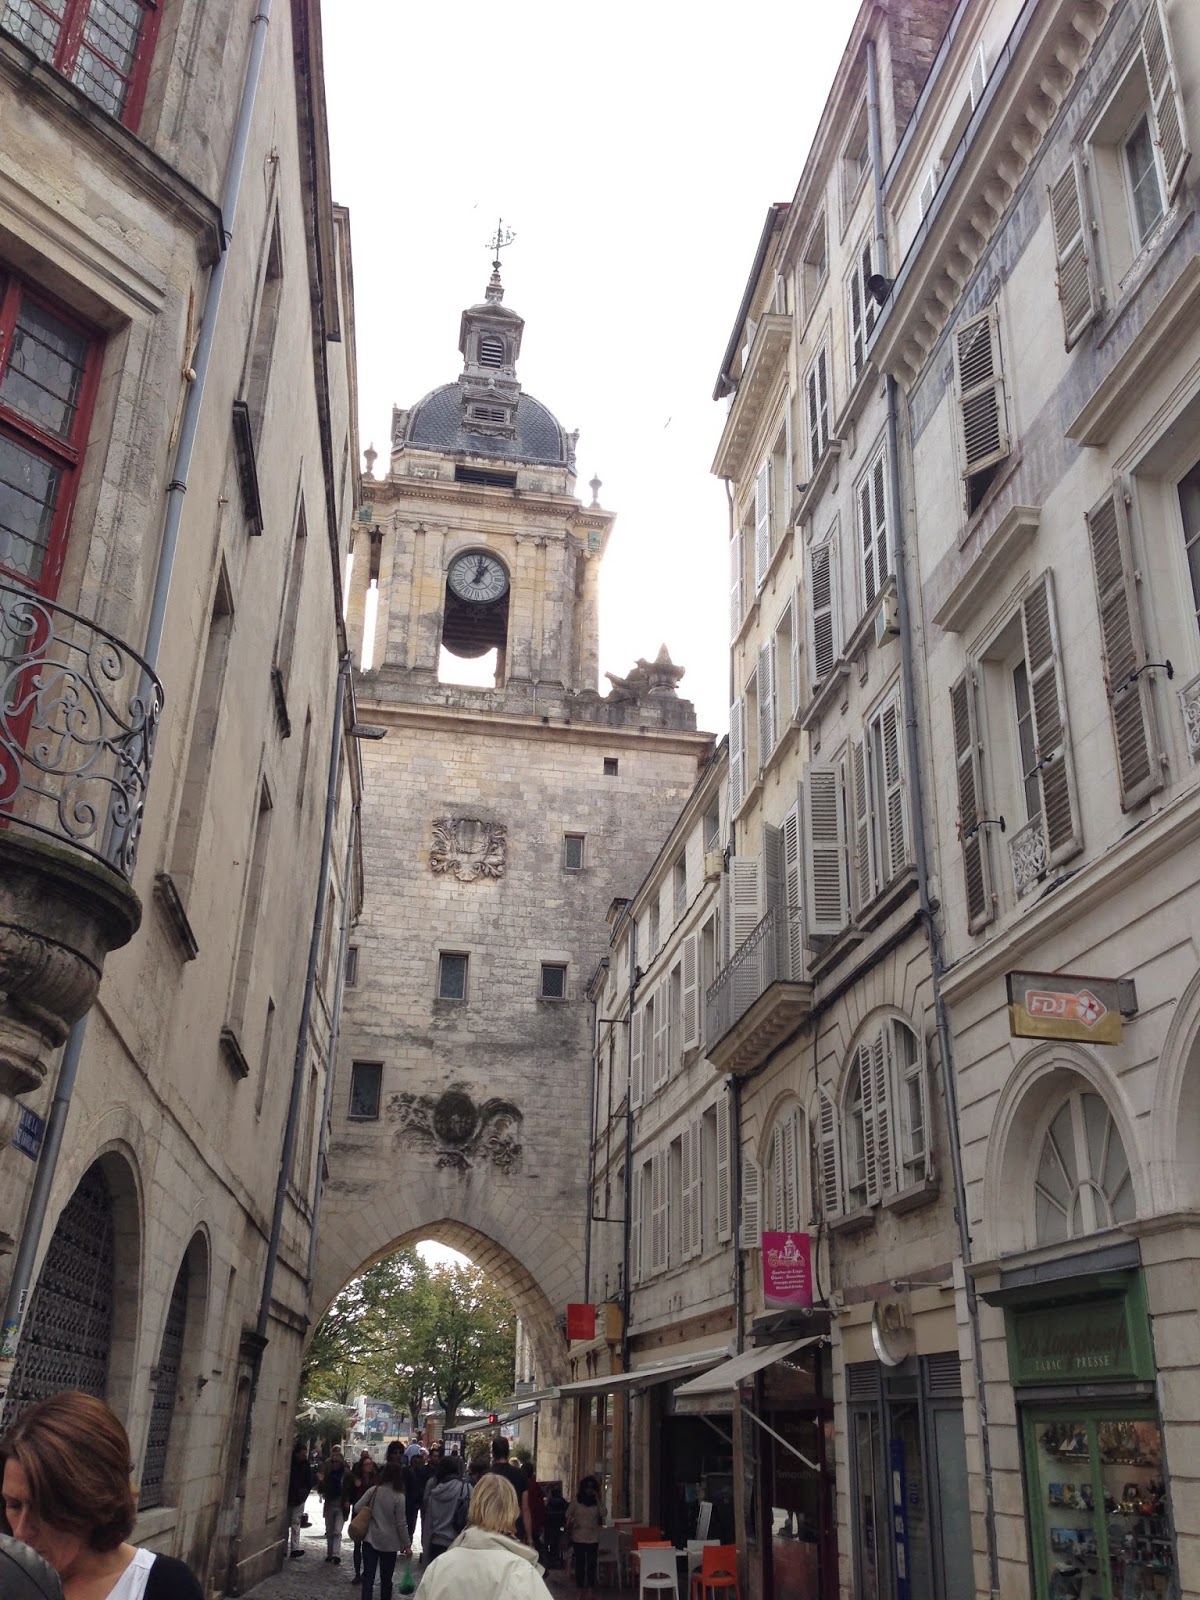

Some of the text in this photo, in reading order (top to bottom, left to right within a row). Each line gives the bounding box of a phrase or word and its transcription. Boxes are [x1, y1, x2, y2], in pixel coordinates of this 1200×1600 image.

[1031, 996, 1067, 1013] FDJ
[1035, 1355, 1110, 1371] TABAC PRESSE
